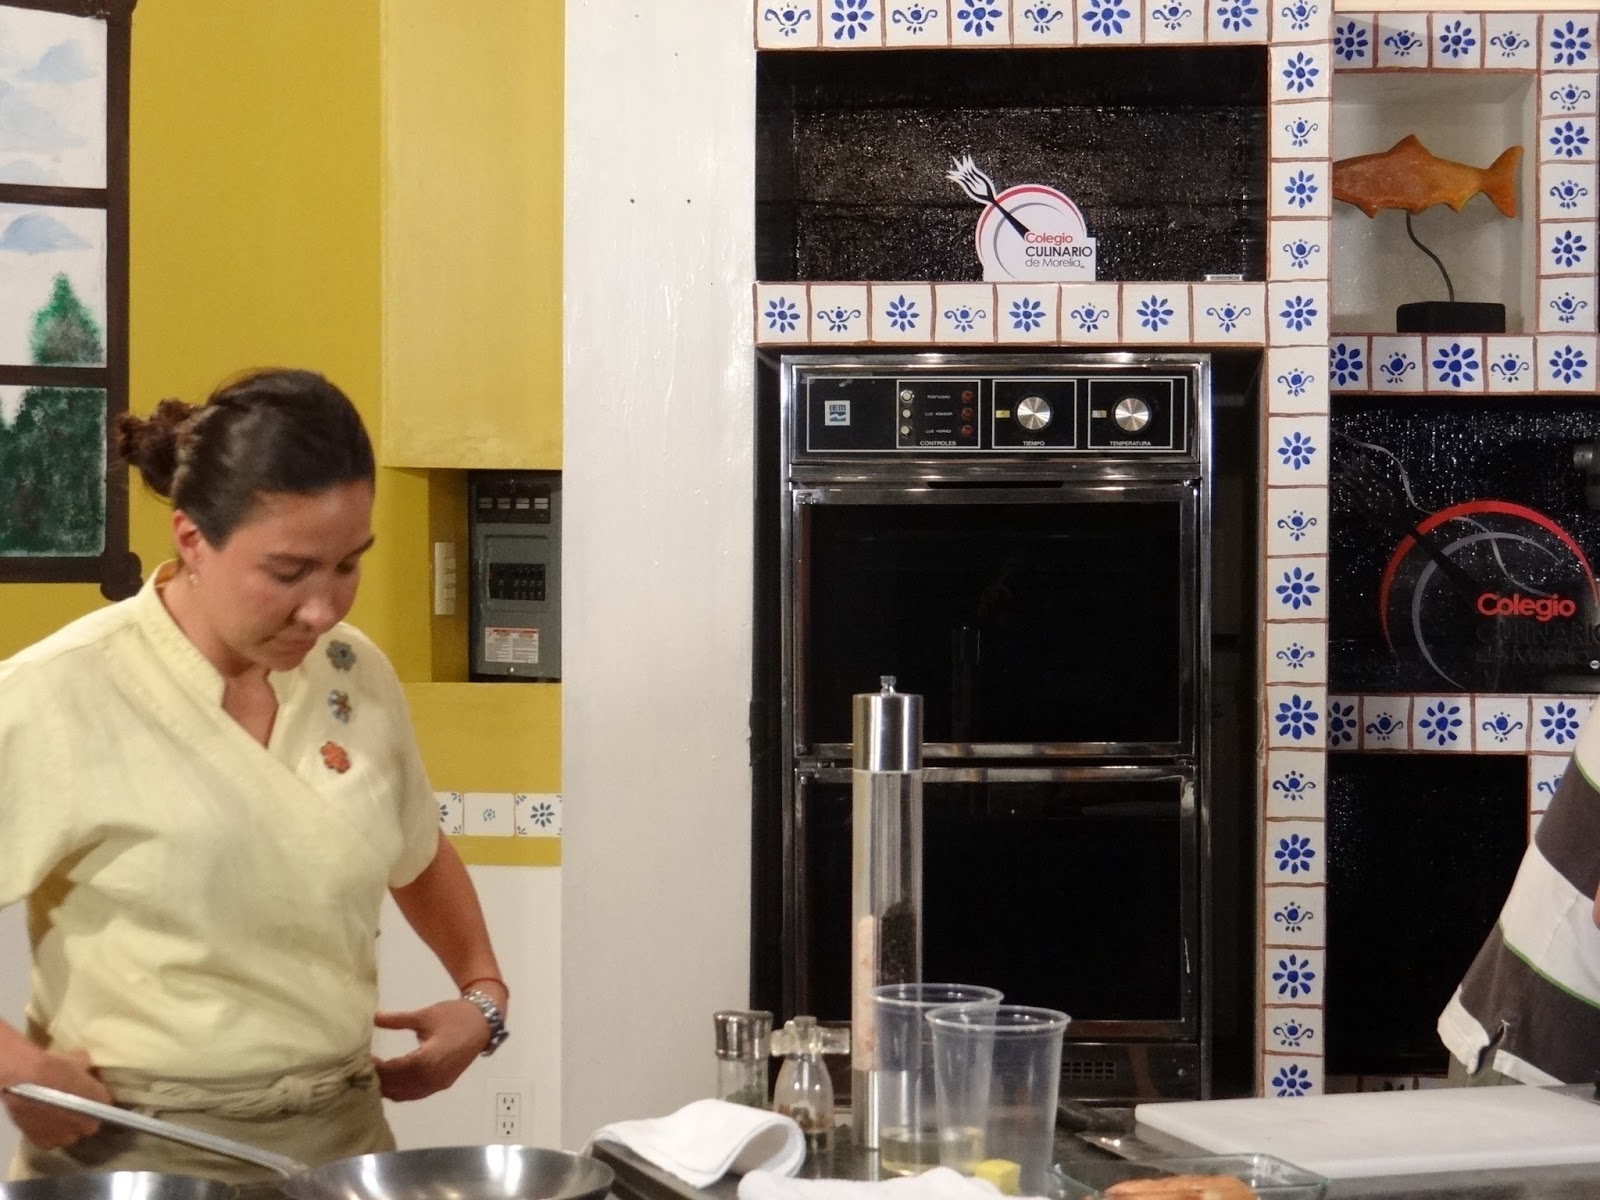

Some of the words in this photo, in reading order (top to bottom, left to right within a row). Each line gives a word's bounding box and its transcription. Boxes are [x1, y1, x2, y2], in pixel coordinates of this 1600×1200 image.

[1025, 232, 1073, 246] Colegio
[1025, 246, 1093, 257] CULINARIO
[1025, 258, 1040, 268] de
[1042, 258, 1081, 268] Morelia
[1477, 592, 1576, 622] Colegio
